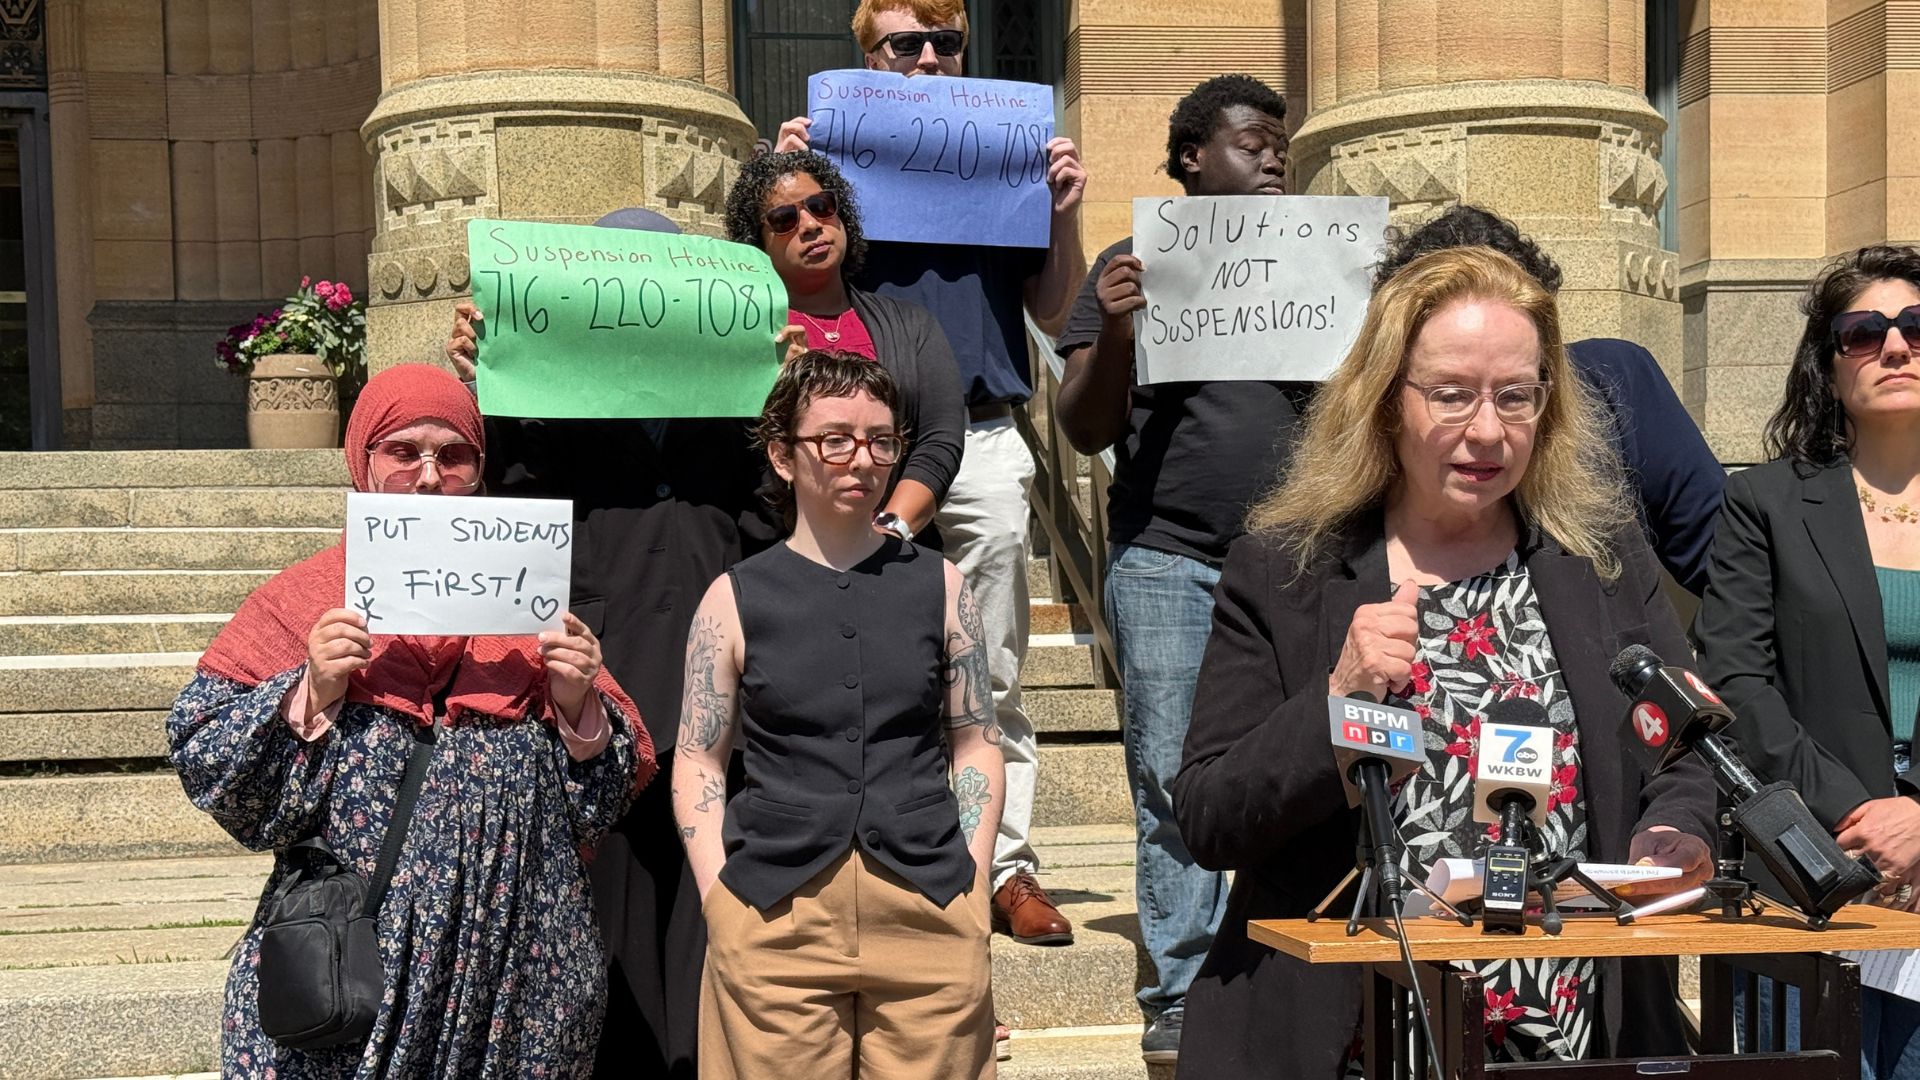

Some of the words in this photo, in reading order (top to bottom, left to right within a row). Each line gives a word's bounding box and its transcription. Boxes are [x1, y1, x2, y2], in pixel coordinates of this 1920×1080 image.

[817, 77, 932, 108] Suspension
[950, 85, 1039, 109] Hotline:
[1157, 199, 1360, 253] Solutions
[489, 227, 652, 271] Suspension
[667, 246, 770, 275] Hotline:
[1210, 257, 1278, 291] NOT
[364, 516, 421, 542] PUT
[450, 516, 570, 550] STUDENTS
[1343, 703, 1409, 731] BTPM
[1637, 707, 1664, 741] 4
[1347, 725, 1406, 748] npr
[1494, 728, 1532, 763] 7
[1487, 764, 1543, 778] WKBW
